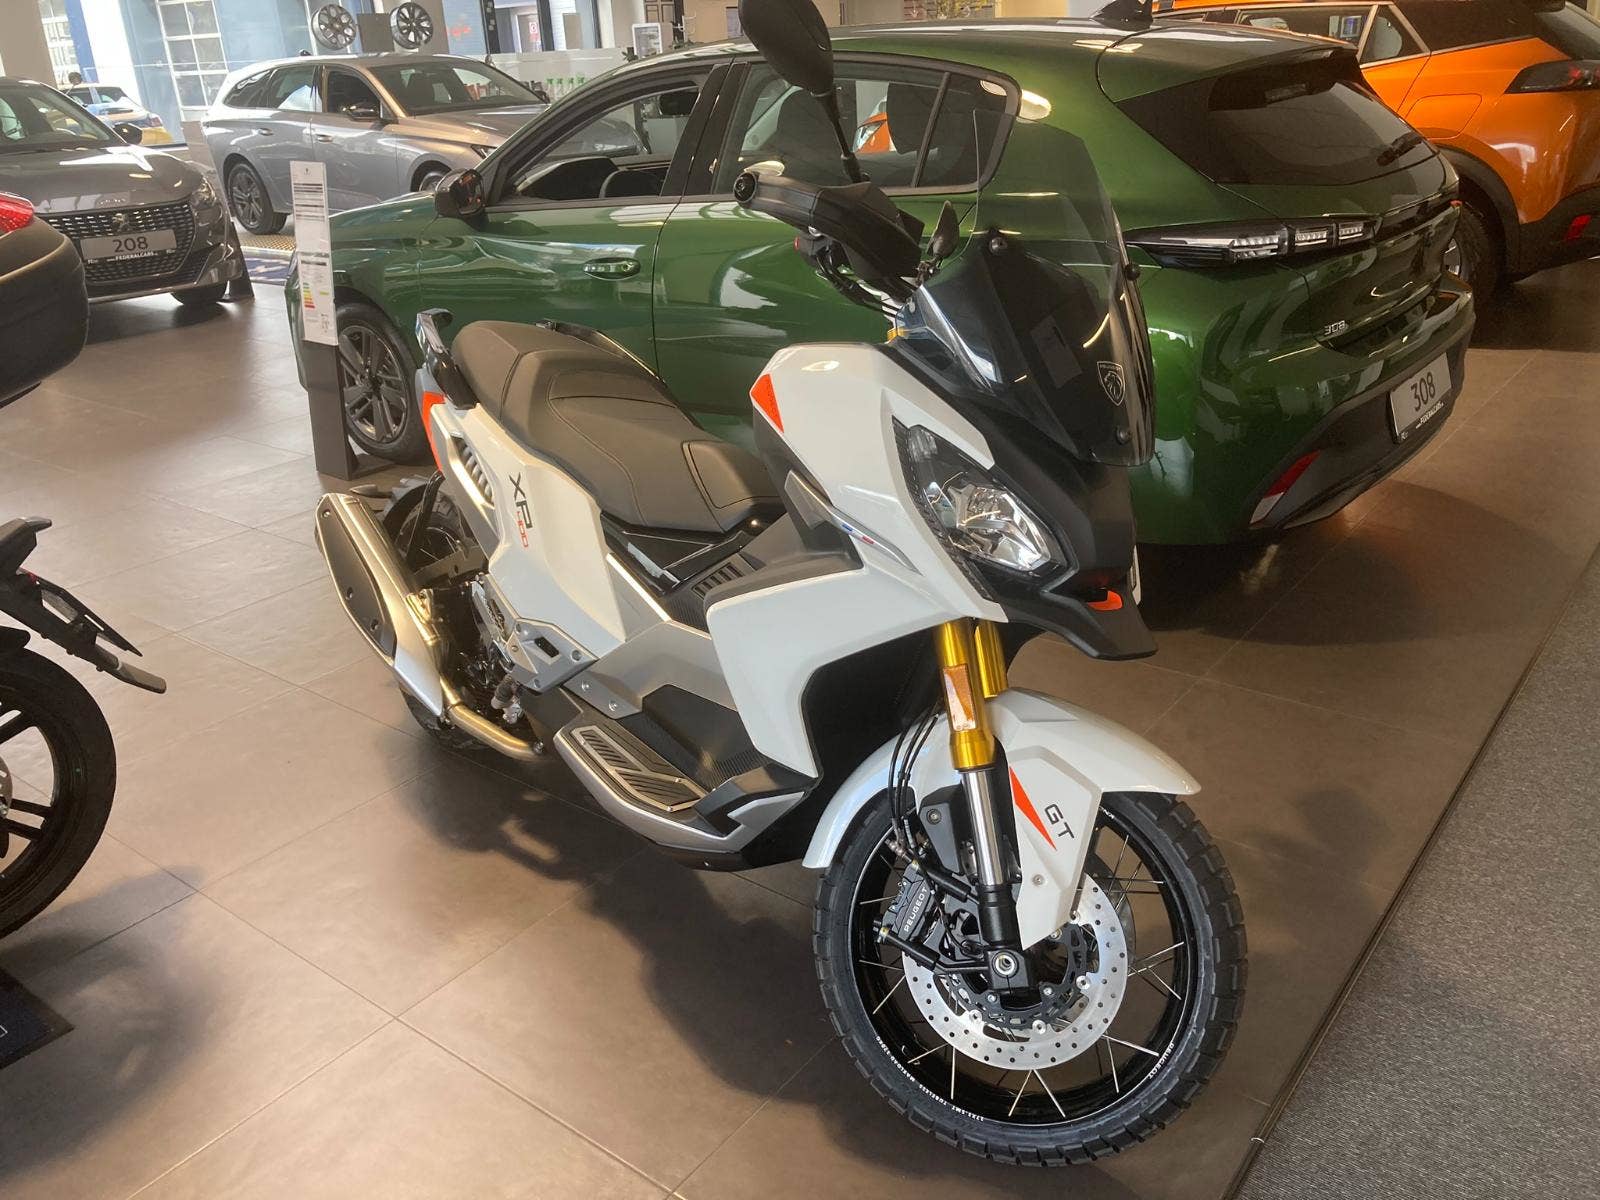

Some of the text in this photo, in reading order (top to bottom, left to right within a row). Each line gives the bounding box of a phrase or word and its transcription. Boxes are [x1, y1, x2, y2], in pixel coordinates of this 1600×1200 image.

[112, 236, 148, 253] 208
[1324, 320, 1346, 336] 308
[1410, 371, 1436, 412] 308
[508, 472, 533, 529] XP
[1044, 803, 1075, 839] GT
[903, 886, 928, 932] PEUGEOT
[1148, 1041, 1175, 1080] PEUGEOT
